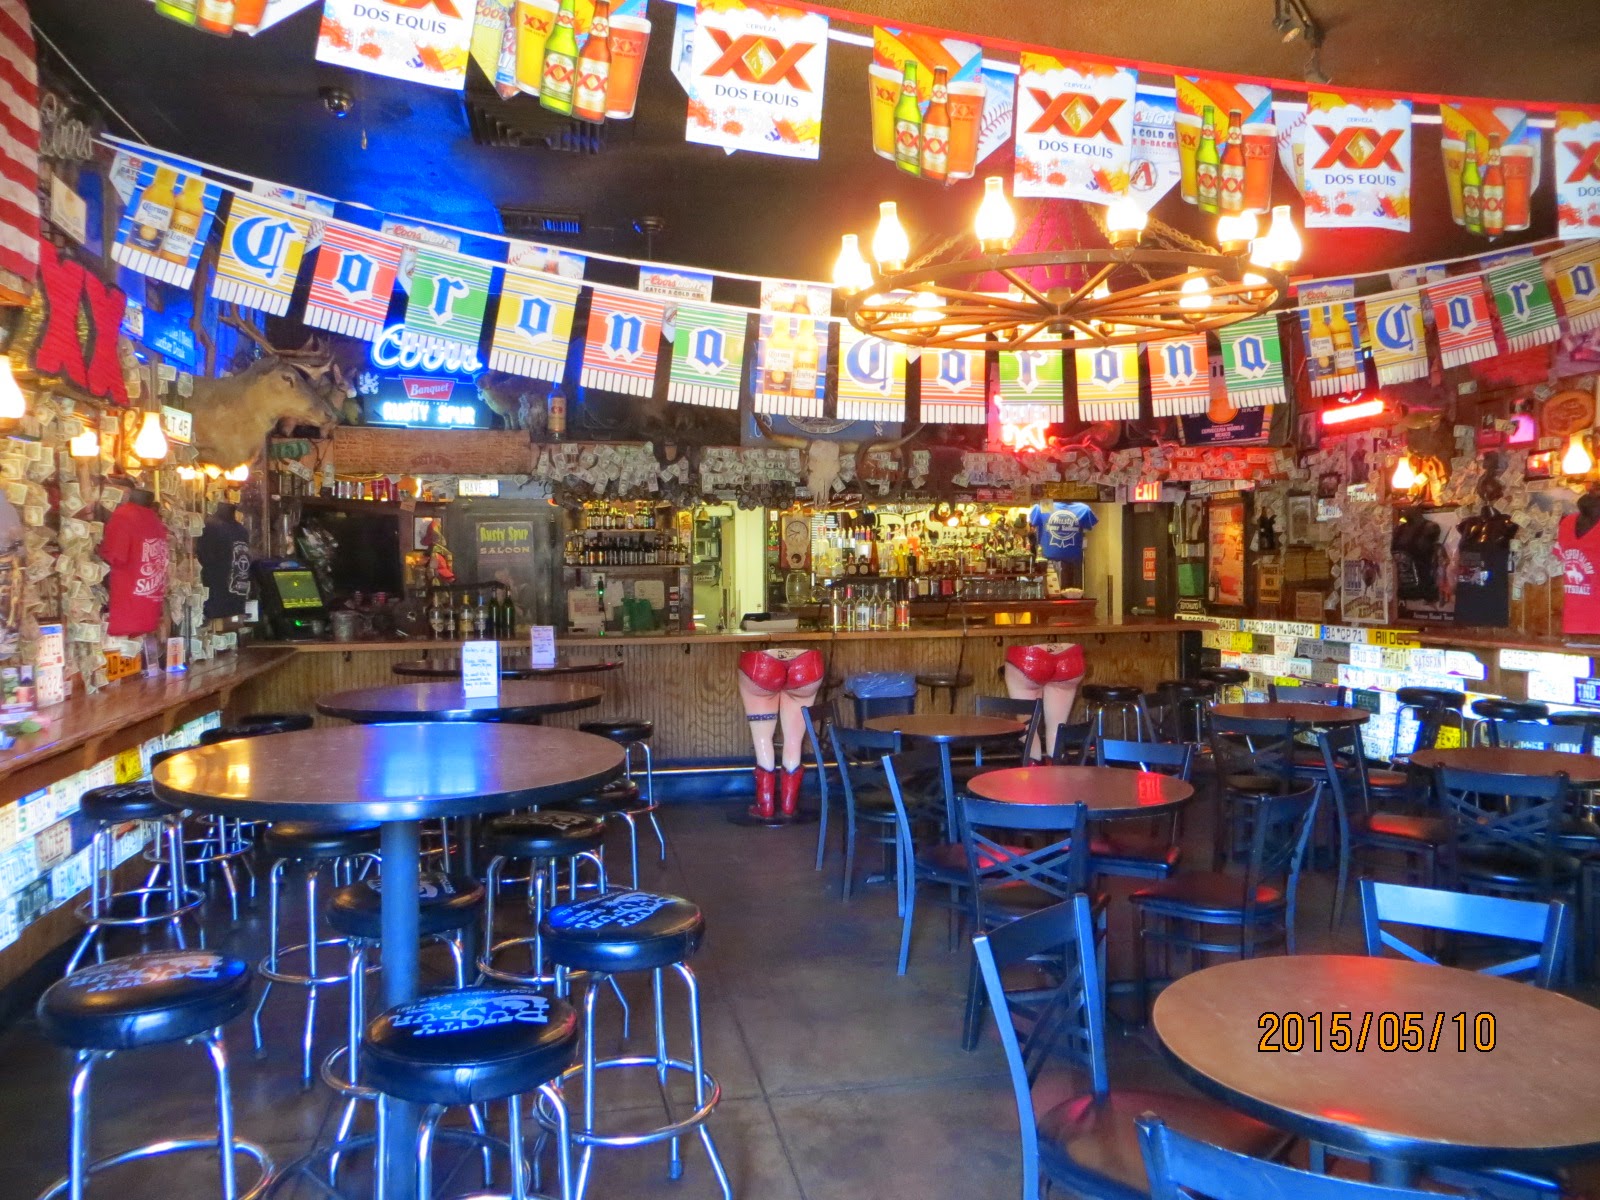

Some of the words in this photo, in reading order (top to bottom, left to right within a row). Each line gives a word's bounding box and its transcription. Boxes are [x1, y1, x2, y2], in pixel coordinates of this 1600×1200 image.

[353, 3, 391, 22] DOS
[395, 14, 447, 34] EQUIS
[745, 23, 777, 33] CERVEZA
[714, 84, 748, 101] DOS
[753, 89, 800, 108] EQUIS
[1140, 129, 1164, 139] COLD
[1038, 139, 1069, 154] DOS
[1074, 142, 1114, 159] EQUIS
[1324, 173, 1354, 185] DOS
[1358, 174, 1396, 186] EQUIS
[392, 224, 422, 241] Coors
[650, 274, 677, 288] Coors
[1306, 290, 1328, 299] Coors
[371, 324, 483, 373] Coors
[410, 383, 449, 396] Banquet
[382, 401, 429, 422] RUSTY
[437, 404, 476, 425] SPUR
[178, 416, 189, 437] 45
[464, 482, 483, 493] HAVE
[1135, 481, 1160, 501] EXIT
[480, 527, 506, 542] Rusty
[507, 526, 529, 542] Spur
[479, 546, 530, 555] SALOON
